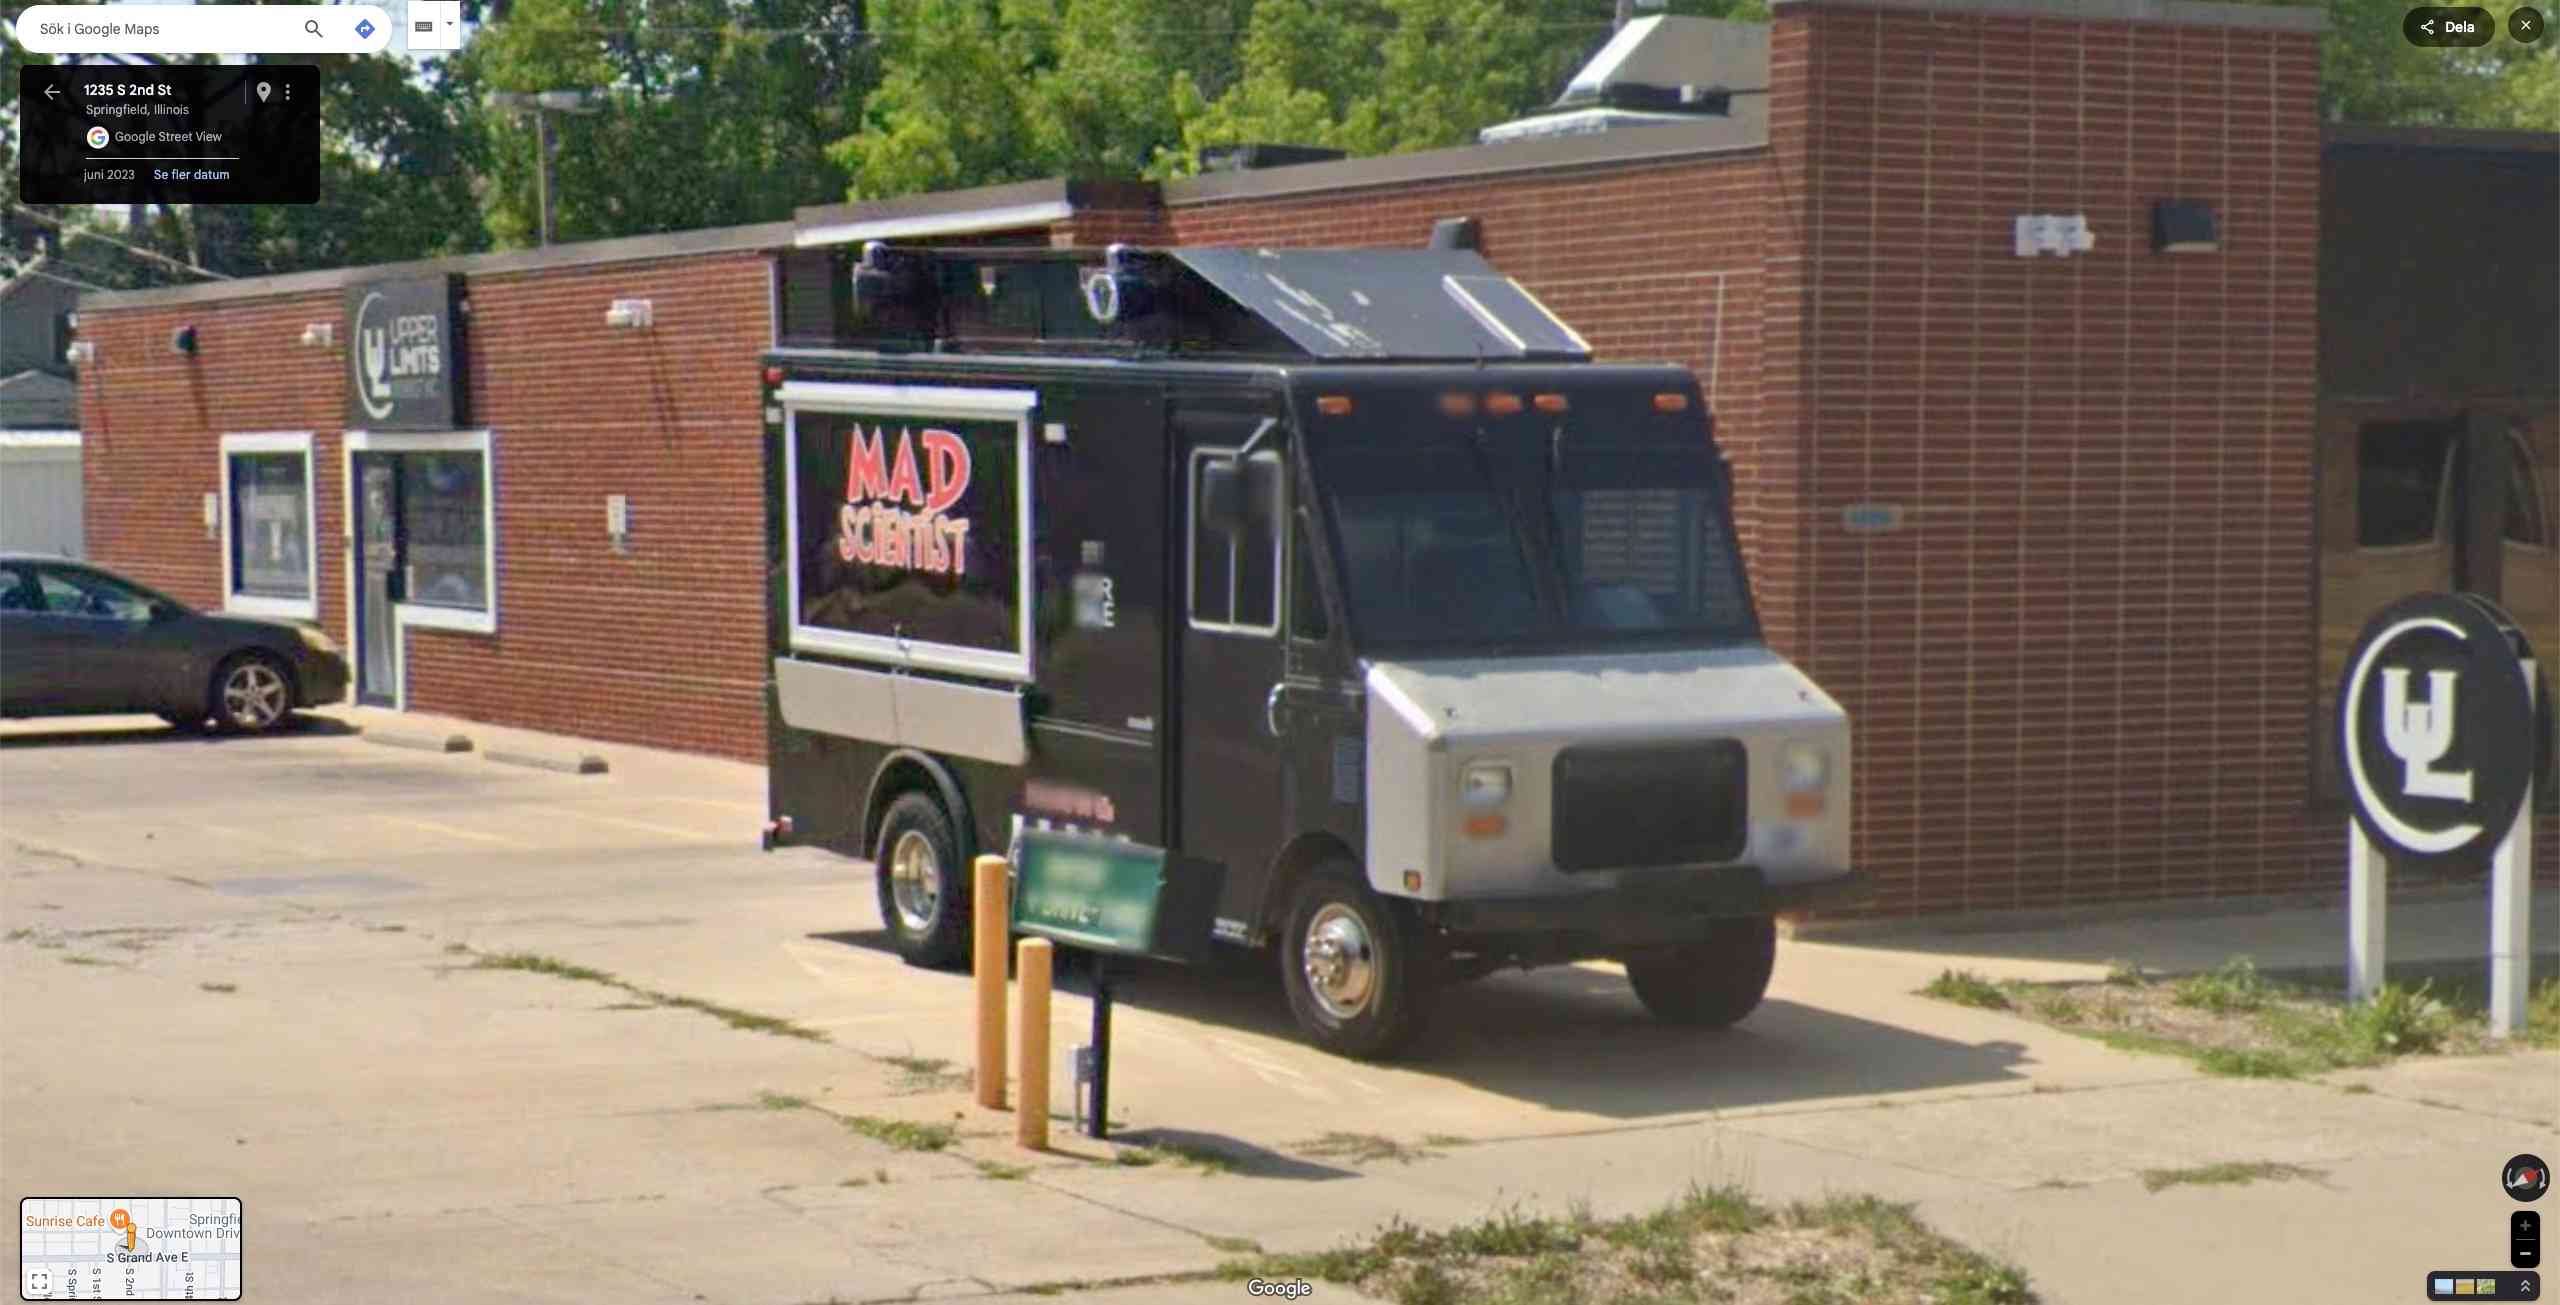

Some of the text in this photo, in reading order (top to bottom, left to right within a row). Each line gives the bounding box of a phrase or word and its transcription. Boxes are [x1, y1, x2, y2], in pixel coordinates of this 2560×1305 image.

[388, 314, 438, 345] UPPER
[390, 345, 441, 376] LIMITS
[847, 423, 971, 514] MAD
[839, 501, 970, 574] SCIENTIST
